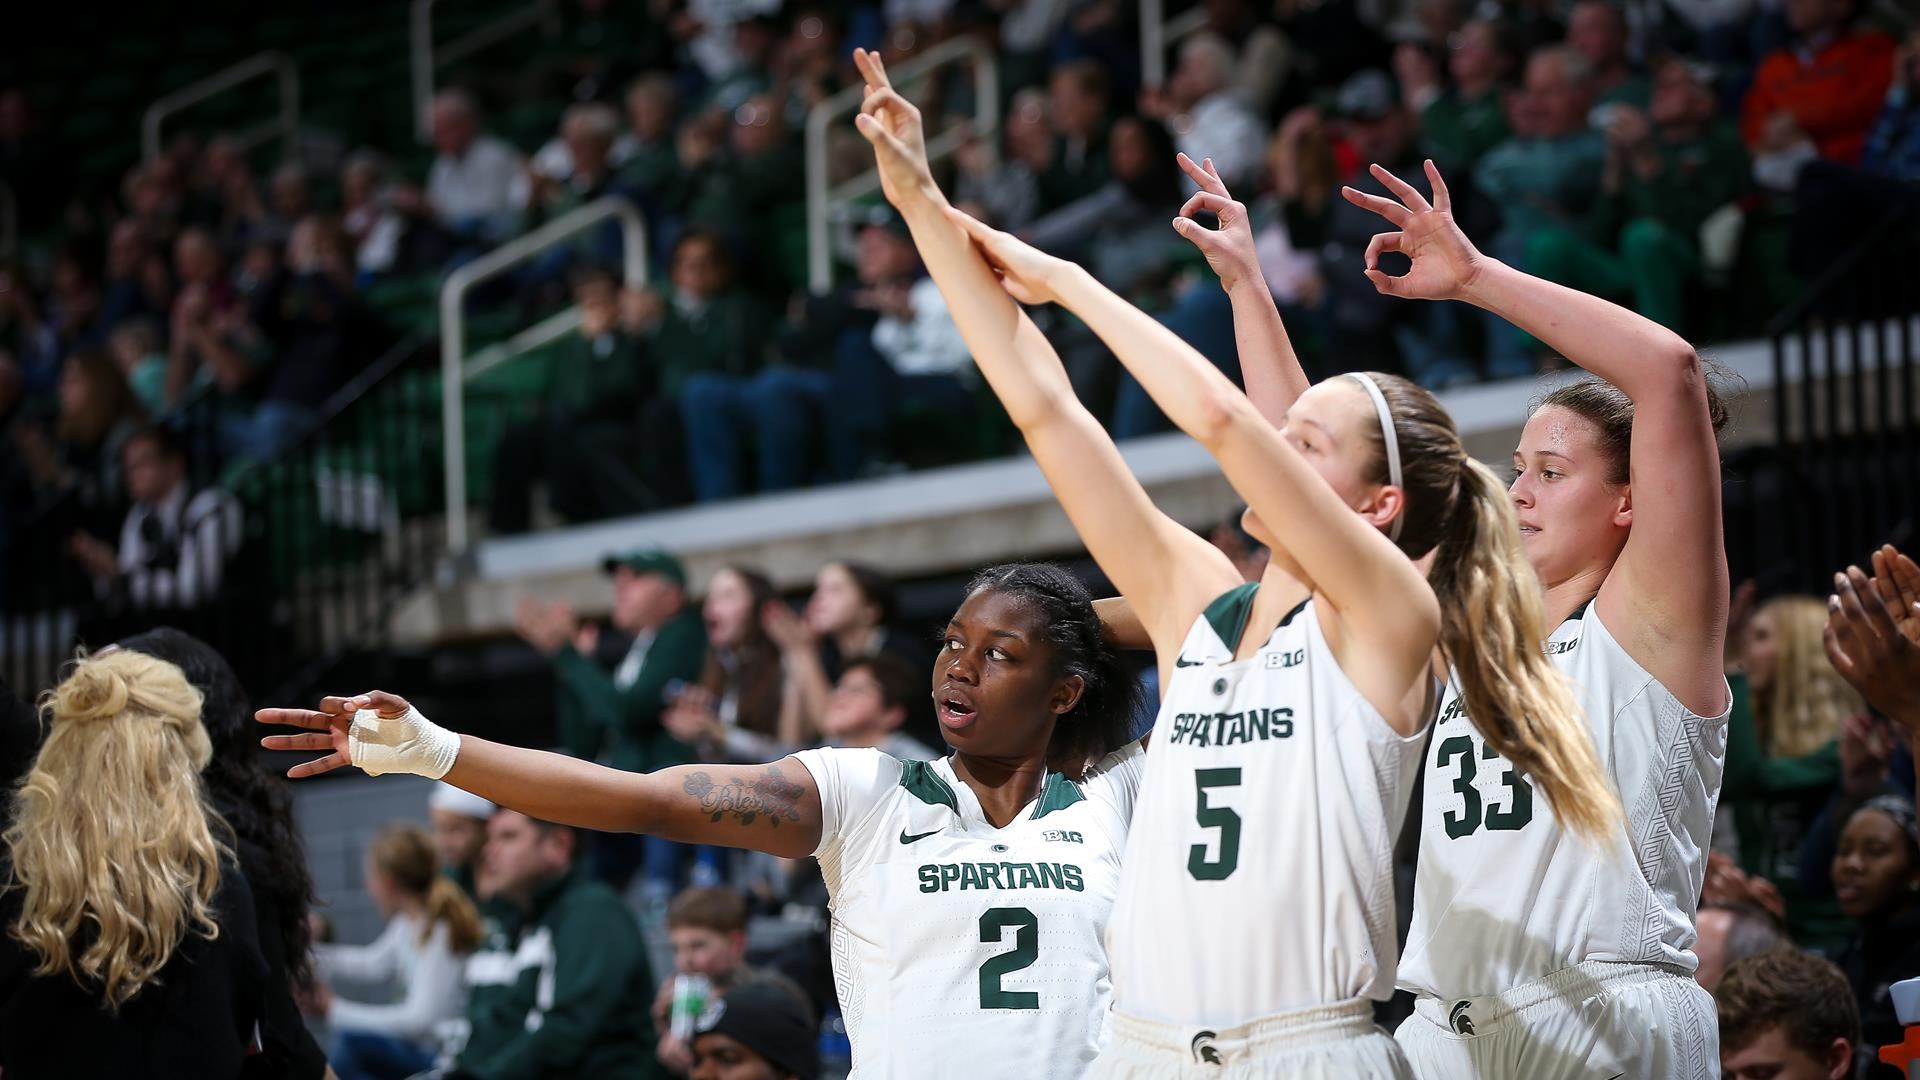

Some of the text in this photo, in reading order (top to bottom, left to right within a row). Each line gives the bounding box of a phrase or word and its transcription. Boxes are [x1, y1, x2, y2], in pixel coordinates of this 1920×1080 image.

[1187, 767, 1242, 881] 5
[1437, 734, 1533, 841] 33
[917, 861, 1085, 893] SPARTANS
[979, 907, 1039, 1009] 2
